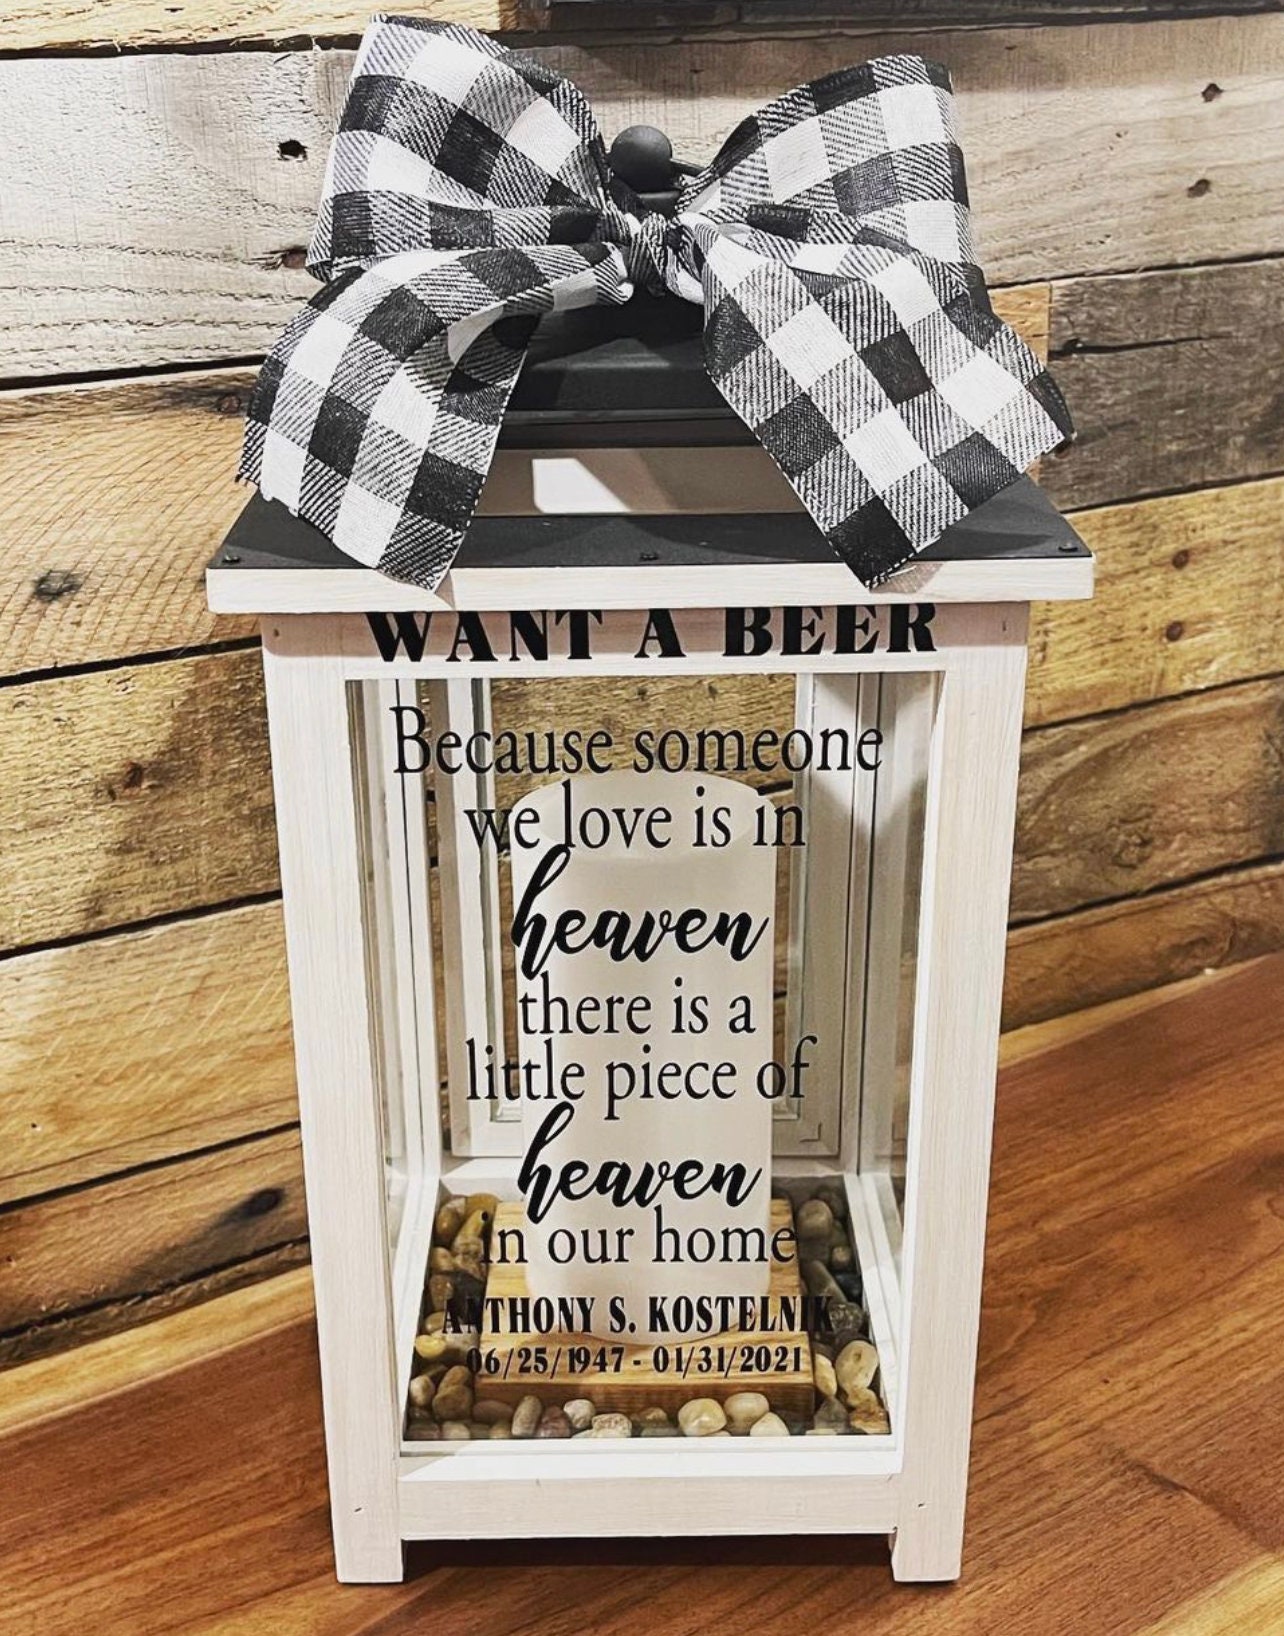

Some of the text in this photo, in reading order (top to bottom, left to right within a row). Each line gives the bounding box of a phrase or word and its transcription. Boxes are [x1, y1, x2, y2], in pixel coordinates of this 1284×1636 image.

[365, 602, 938, 662] WANT A BEER
[390, 705, 883, 774] Because someone
[464, 779, 806, 849] we love is in
[510, 843, 769, 981] heaven
[519, 971, 756, 1034] there is a
[466, 1035, 818, 1120] little piece of
[517, 1101, 763, 1224] heaven
[480, 1205, 799, 1264] in our home
[441, 1295, 834, 1336] ANTHONY S. KOSTELNIK
[466, 1347, 624, 1378] 06/25/1947
[653, 1345, 801, 1378] 01/31/2021
